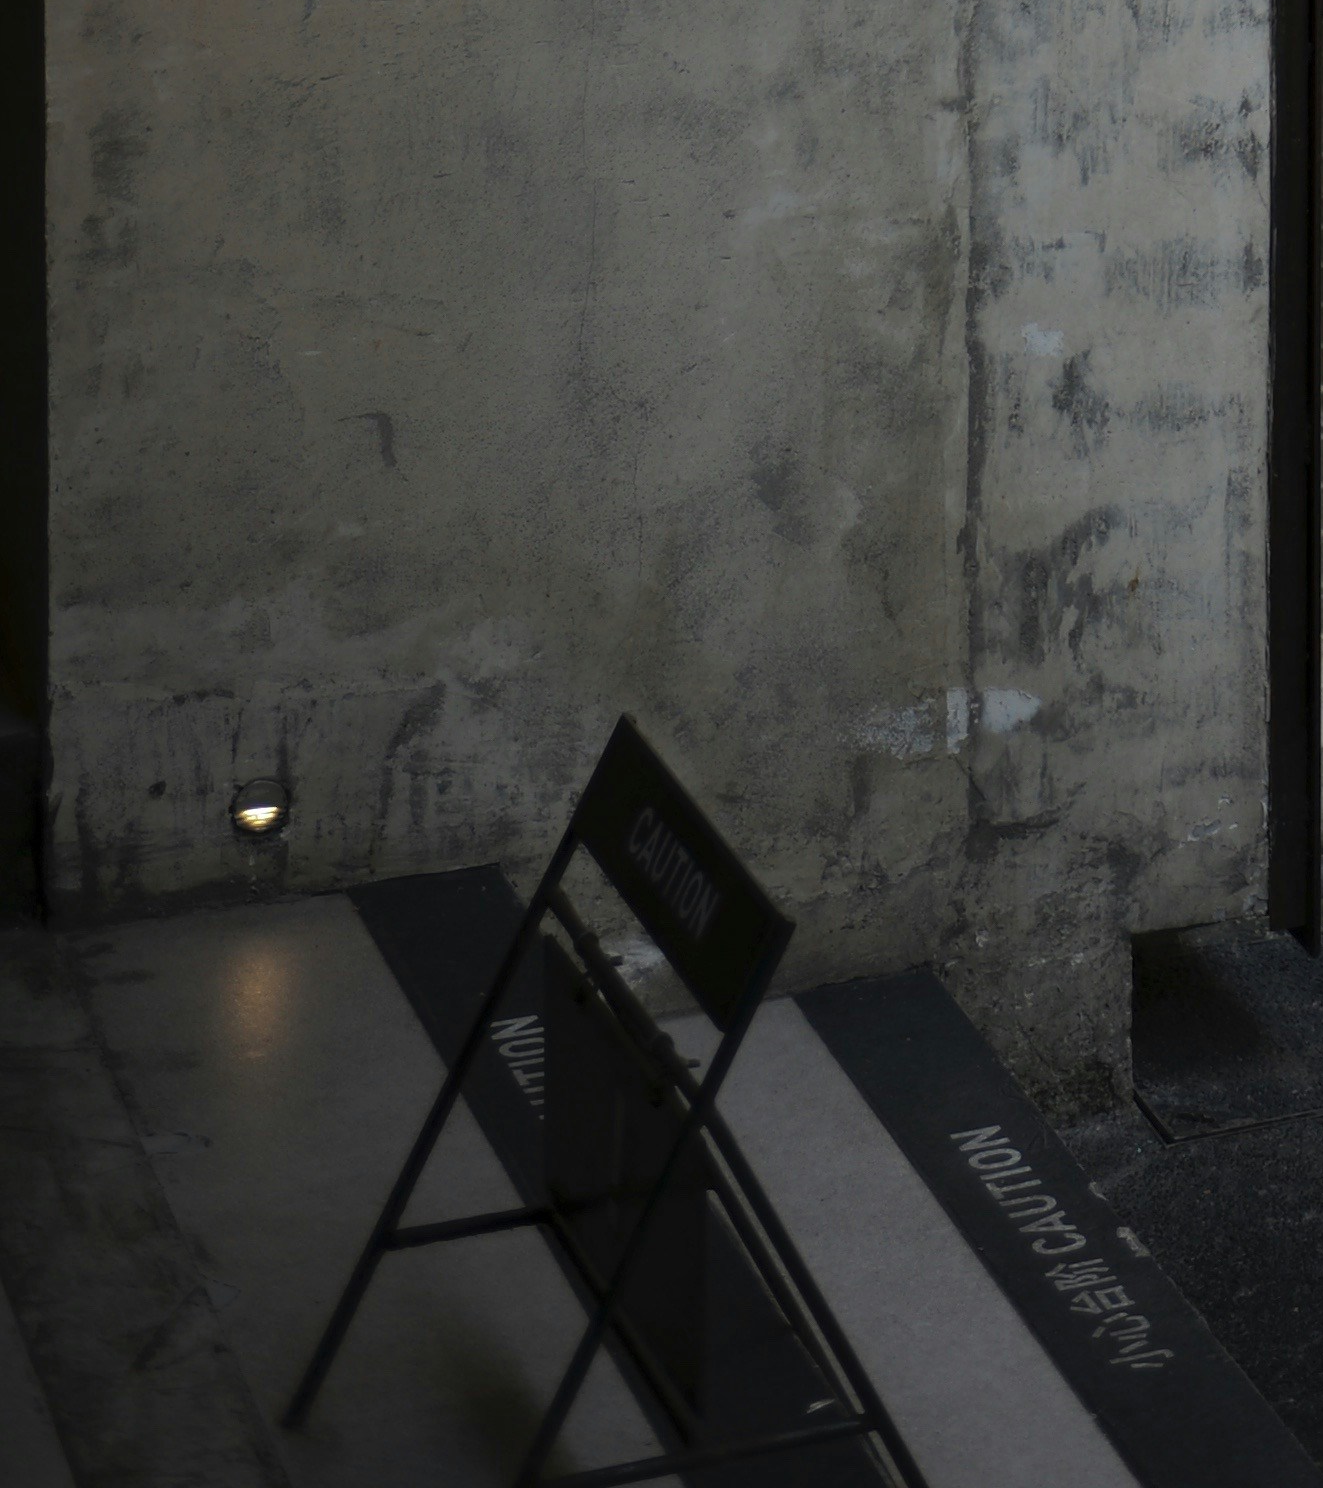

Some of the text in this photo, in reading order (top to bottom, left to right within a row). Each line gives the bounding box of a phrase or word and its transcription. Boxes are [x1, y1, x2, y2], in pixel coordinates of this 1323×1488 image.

[628, 805, 721, 941] CAUTION
[949, 1124, 1175, 1369] 小心台阶 CAUTION
